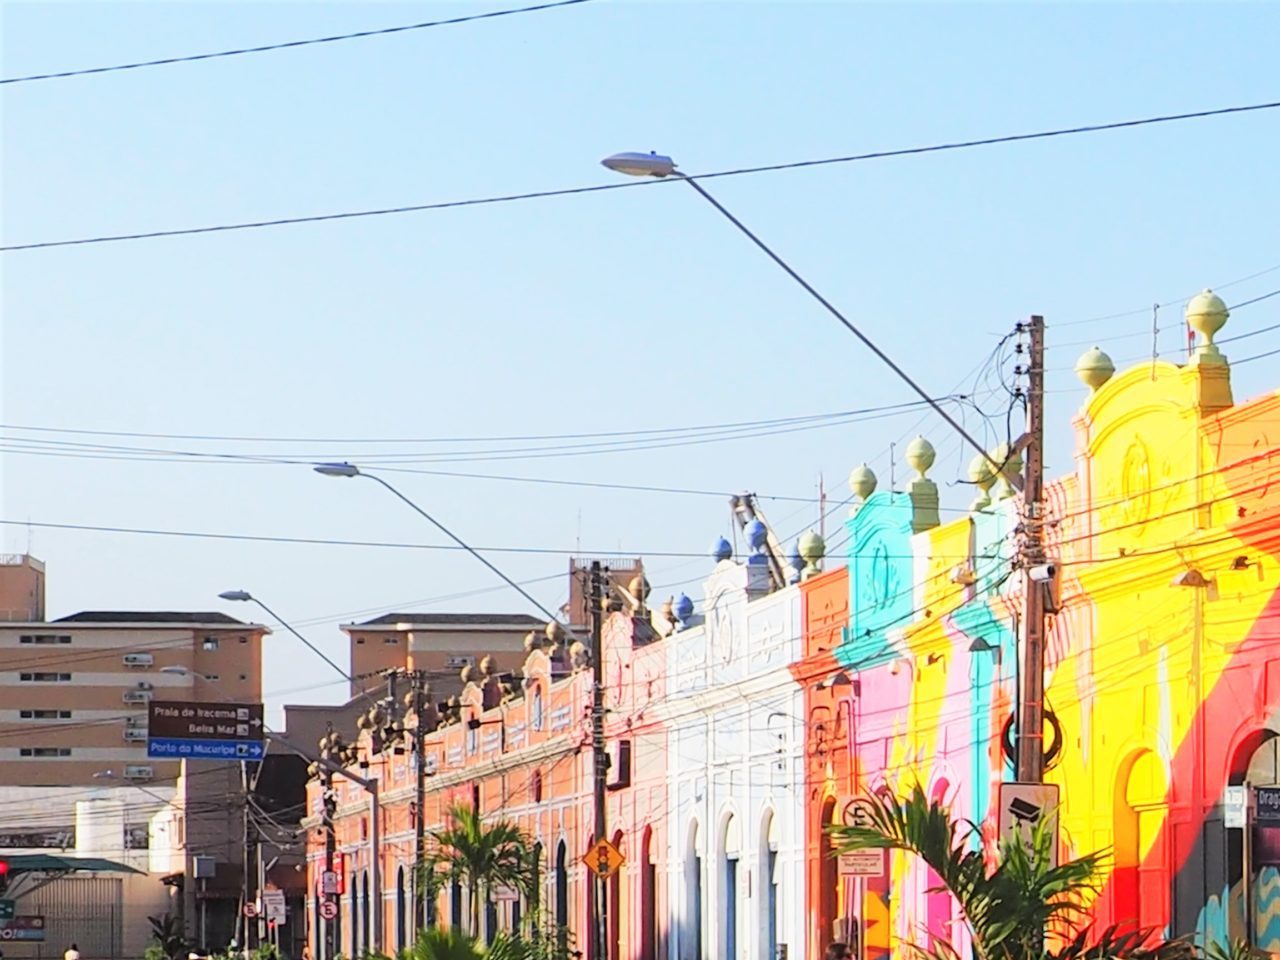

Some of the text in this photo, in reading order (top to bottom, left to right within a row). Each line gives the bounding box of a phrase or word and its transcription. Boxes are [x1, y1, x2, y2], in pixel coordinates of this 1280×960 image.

[154, 707, 236, 719] Praia de Iracema
[189, 724, 235, 735] Beira Mar
[151, 742, 177, 753] Porto
[193, 745, 235, 756] Mucuripe
